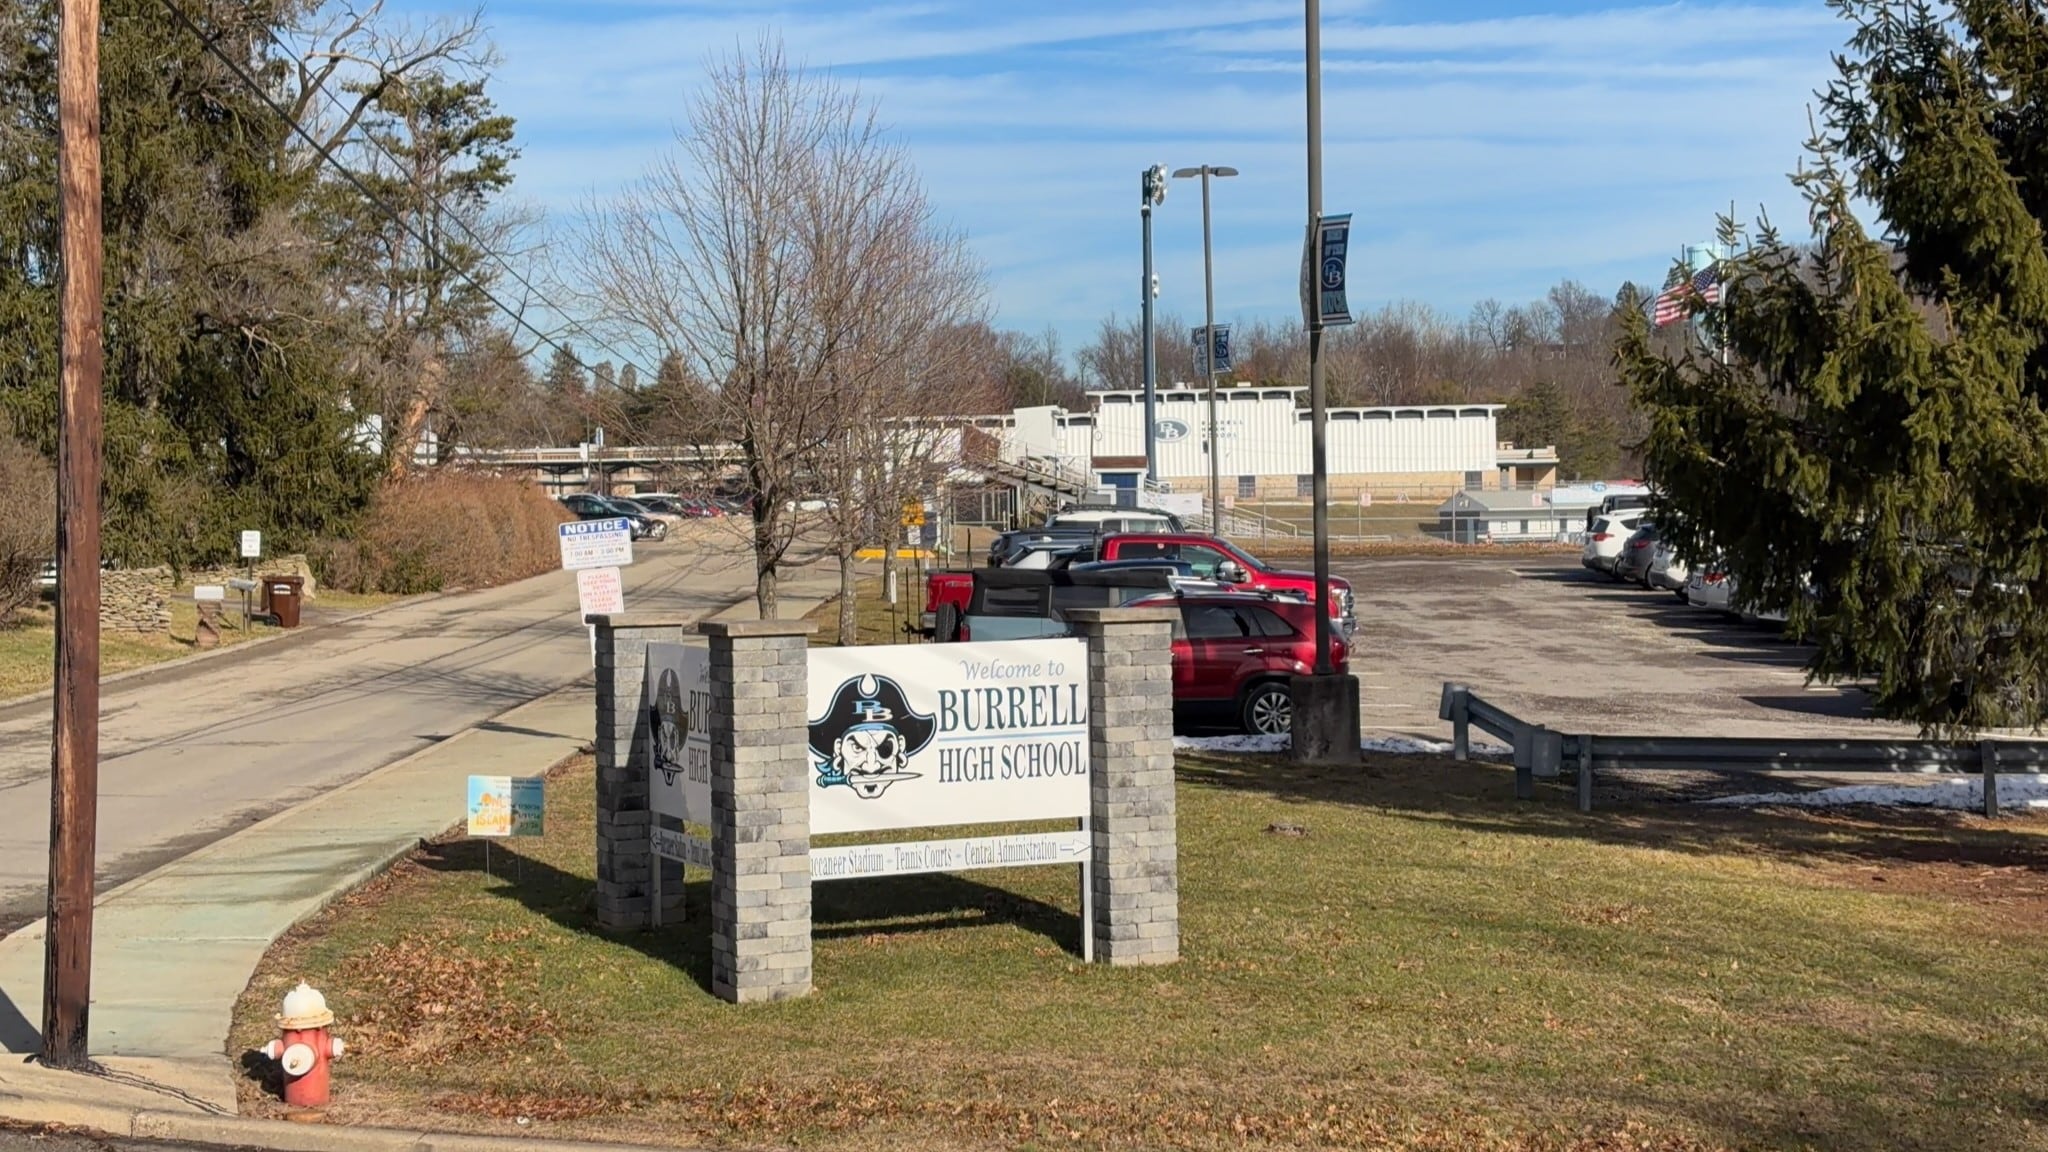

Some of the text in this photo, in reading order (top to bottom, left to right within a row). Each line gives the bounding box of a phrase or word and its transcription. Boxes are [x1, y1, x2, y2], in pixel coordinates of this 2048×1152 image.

[564, 519, 624, 535] NOTICE
[960, 659, 1065, 681] Welcome to
[938, 683, 1087, 732] BURRELL
[688, 746, 708, 785] HIGH
[939, 740, 1087, 783] HIGH SCHOOL
[848, 848, 884, 874] Stadium
[894, 843, 922, 871] Tennis
[924, 843, 952, 869] Courts
[964, 839, 995, 866] Central
[996, 836, 1057, 863] Administration
